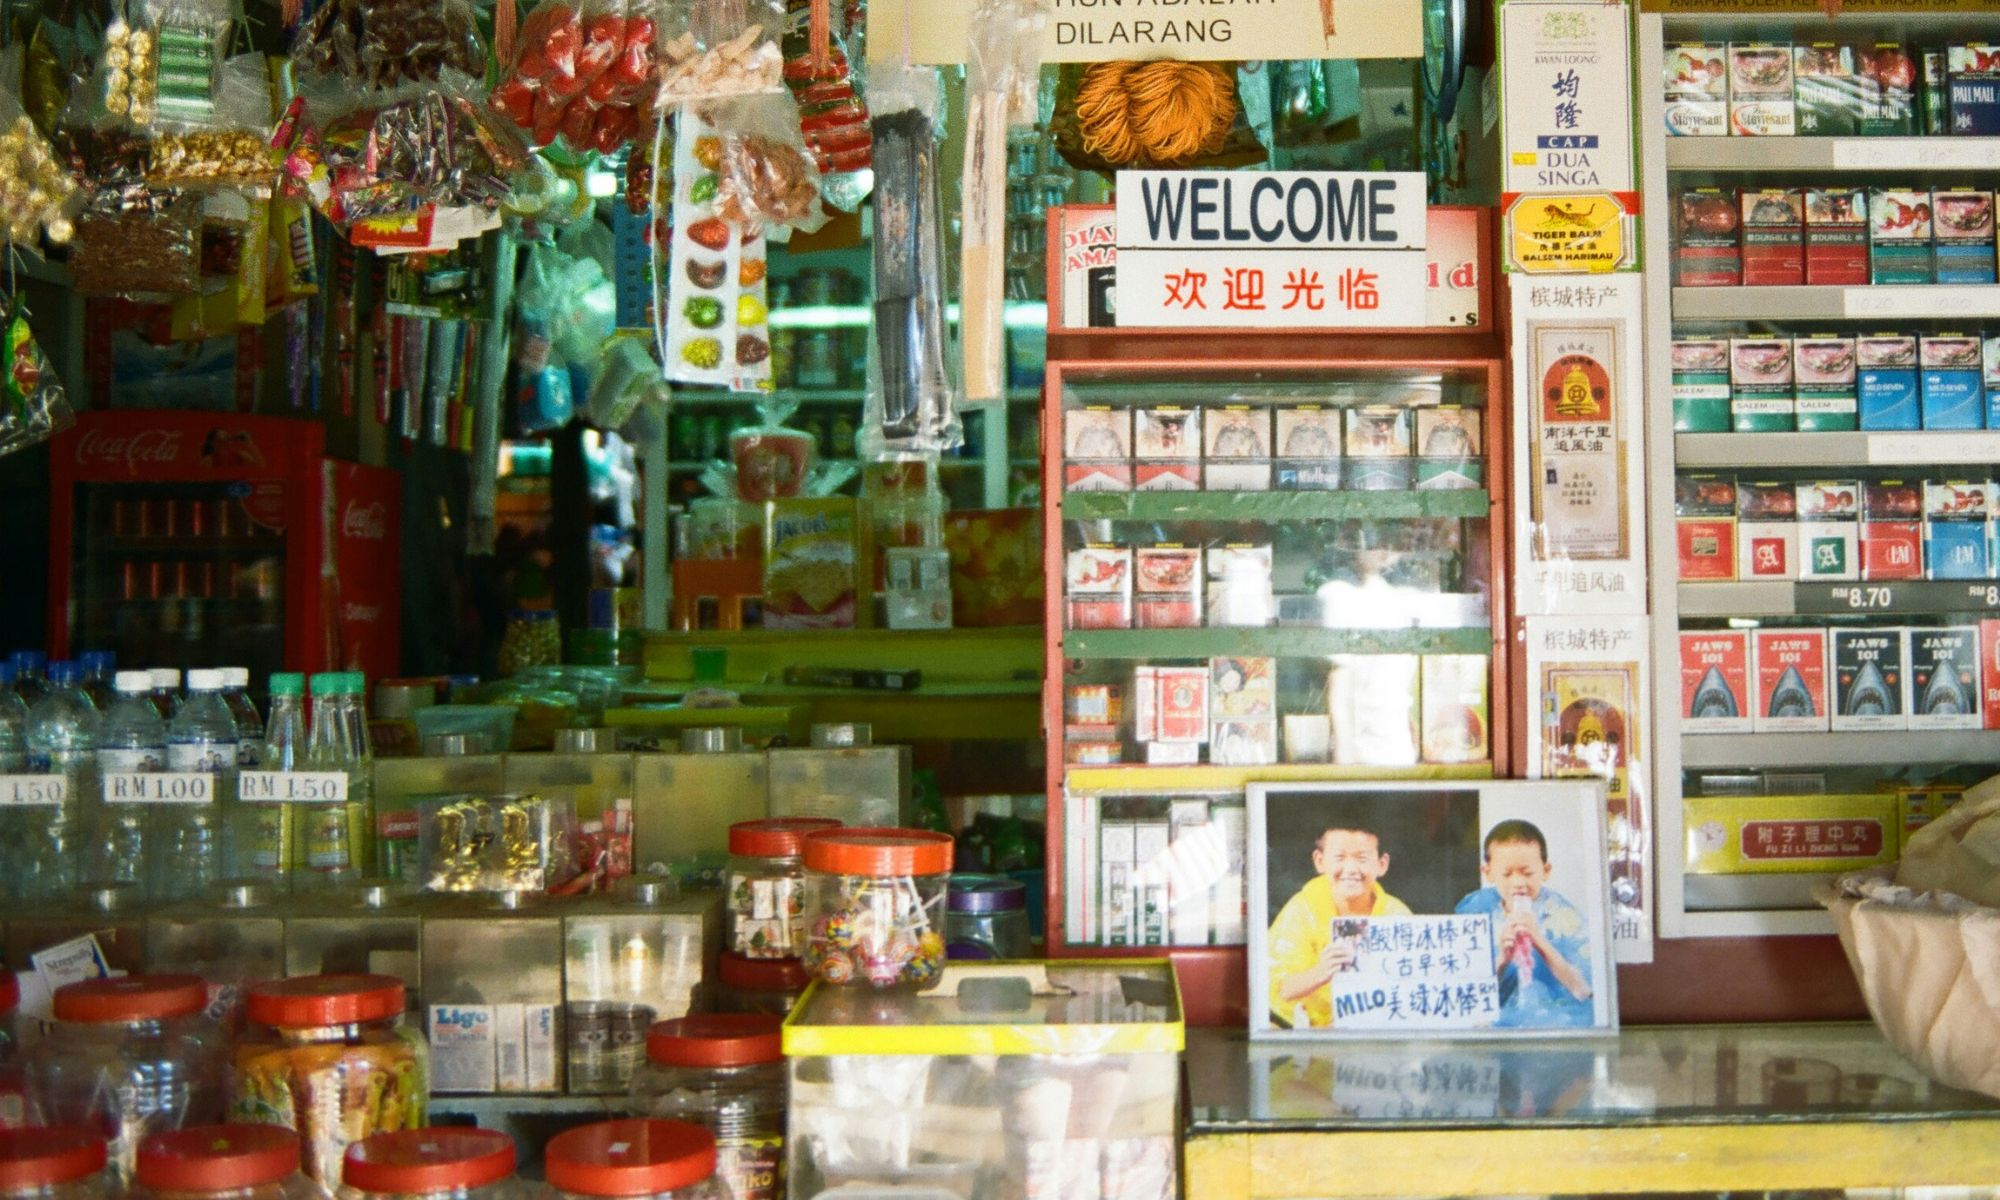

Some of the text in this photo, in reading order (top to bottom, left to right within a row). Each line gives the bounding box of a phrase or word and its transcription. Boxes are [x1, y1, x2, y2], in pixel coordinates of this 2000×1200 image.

[1057, 19, 1232, 45] DILARANG
[1953, 86, 1995, 103] PALL MALL
[1548, 136, 1588, 149] CAP
[1547, 153, 1590, 168] DUA
[1538, 171, 1599, 187] SINGA
[1141, 177, 1398, 242] WELCOME
[1533, 230, 1602, 240] TIGER BALM
[1565, 252, 1614, 261] HARIMAU
[1163, 267, 1379, 311] 欢迎光临
[1832, 587, 1892, 607] RM 8.70
[1968, 586, 1986, 596] RM
[1692, 641, 1733, 652] JAWS
[1769, 640, 1811, 651] JAWS
[1847, 638, 1889, 649] JAWS
[1922, 637, 1963, 648] JAWS
[114, 777, 206, 799] RM 1.00
[243, 775, 337, 800] RM 1.50
[1335, 988, 1387, 1019] MILO
[436, 1008, 488, 1028] Ligo
